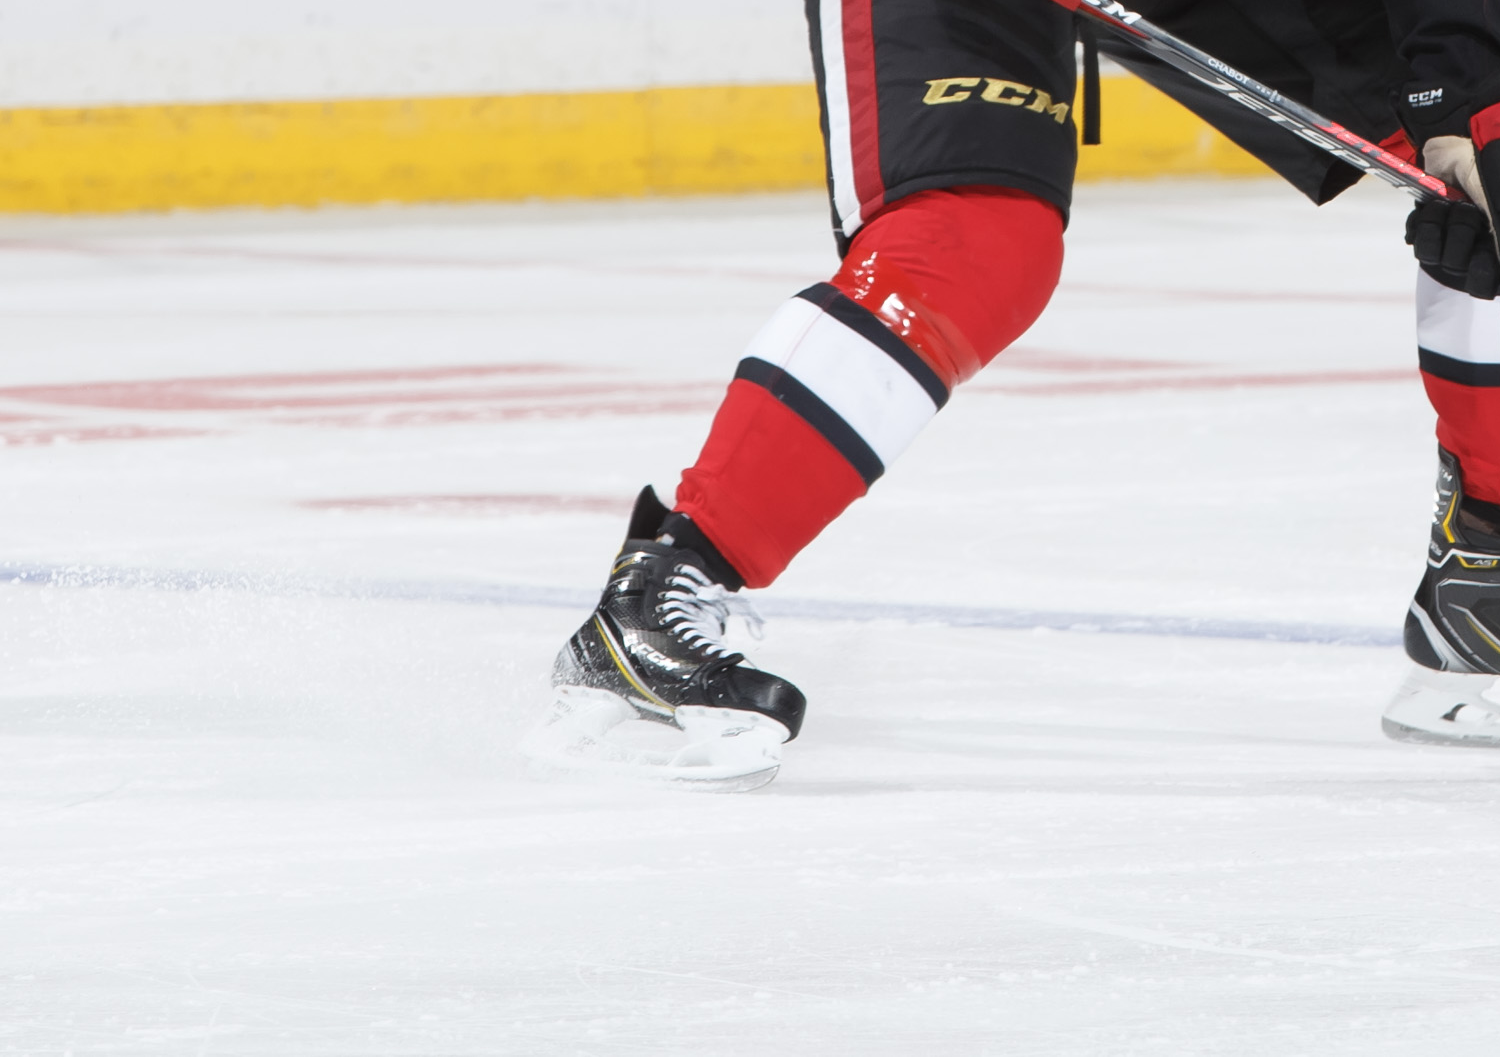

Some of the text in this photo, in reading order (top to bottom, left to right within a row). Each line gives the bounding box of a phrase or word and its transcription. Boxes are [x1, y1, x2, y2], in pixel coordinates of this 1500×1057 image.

[1207, 56, 1251, 85] CHABOT
[921, 77, 1072, 125] CCM
[1407, 87, 1444, 103] CCM
